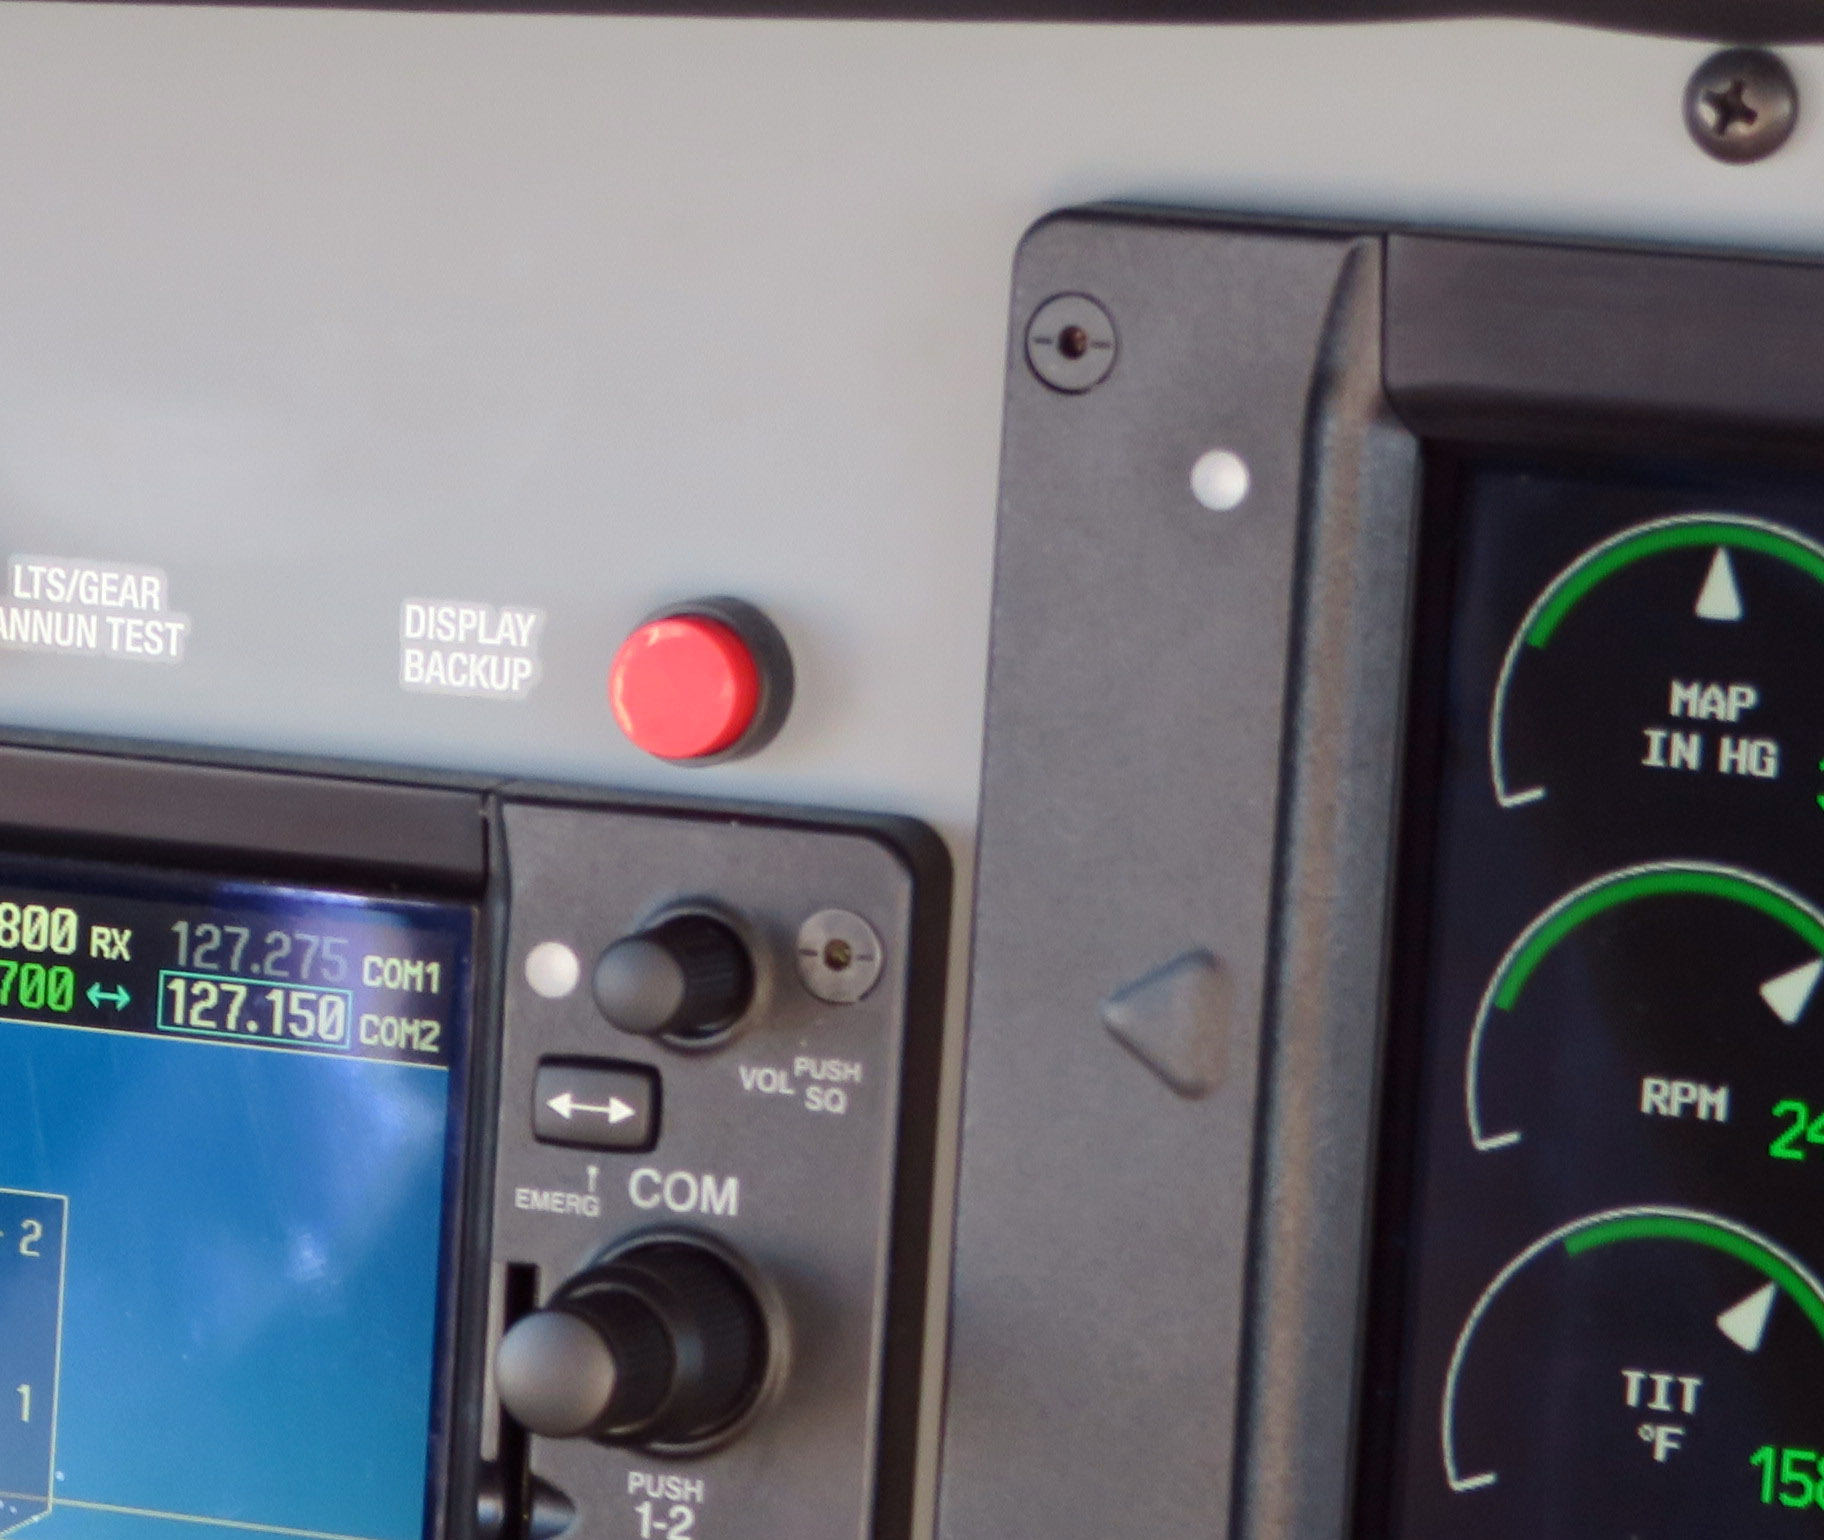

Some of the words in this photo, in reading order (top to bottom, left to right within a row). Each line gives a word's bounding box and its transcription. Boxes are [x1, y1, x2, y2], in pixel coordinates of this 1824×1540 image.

[12, 564, 162, 610] LTS/GEAR
[105, 615, 185, 658] TEST
[404, 604, 536, 649] DISPLAY
[404, 648, 533, 691] BACKUP
[1670, 680, 1756, 722] MAP
[1642, 728, 1701, 769] IN
[1719, 737, 1779, 778] HG
[170, 917, 350, 983] 127.275
[362, 953, 441, 995] COM1
[167, 977, 348, 1043] 127.150
[358, 1011, 441, 1053] COM2
[739, 1065, 794, 1095] VOL
[795, 1056, 861, 1083] PUSH
[1640, 1077, 1729, 1122] RPM
[515, 1188, 600, 1218] EMERG
[628, 1168, 740, 1216] COM
[1621, 1369, 1702, 1414] TIT
[628, 1471, 704, 1503] PUSH
